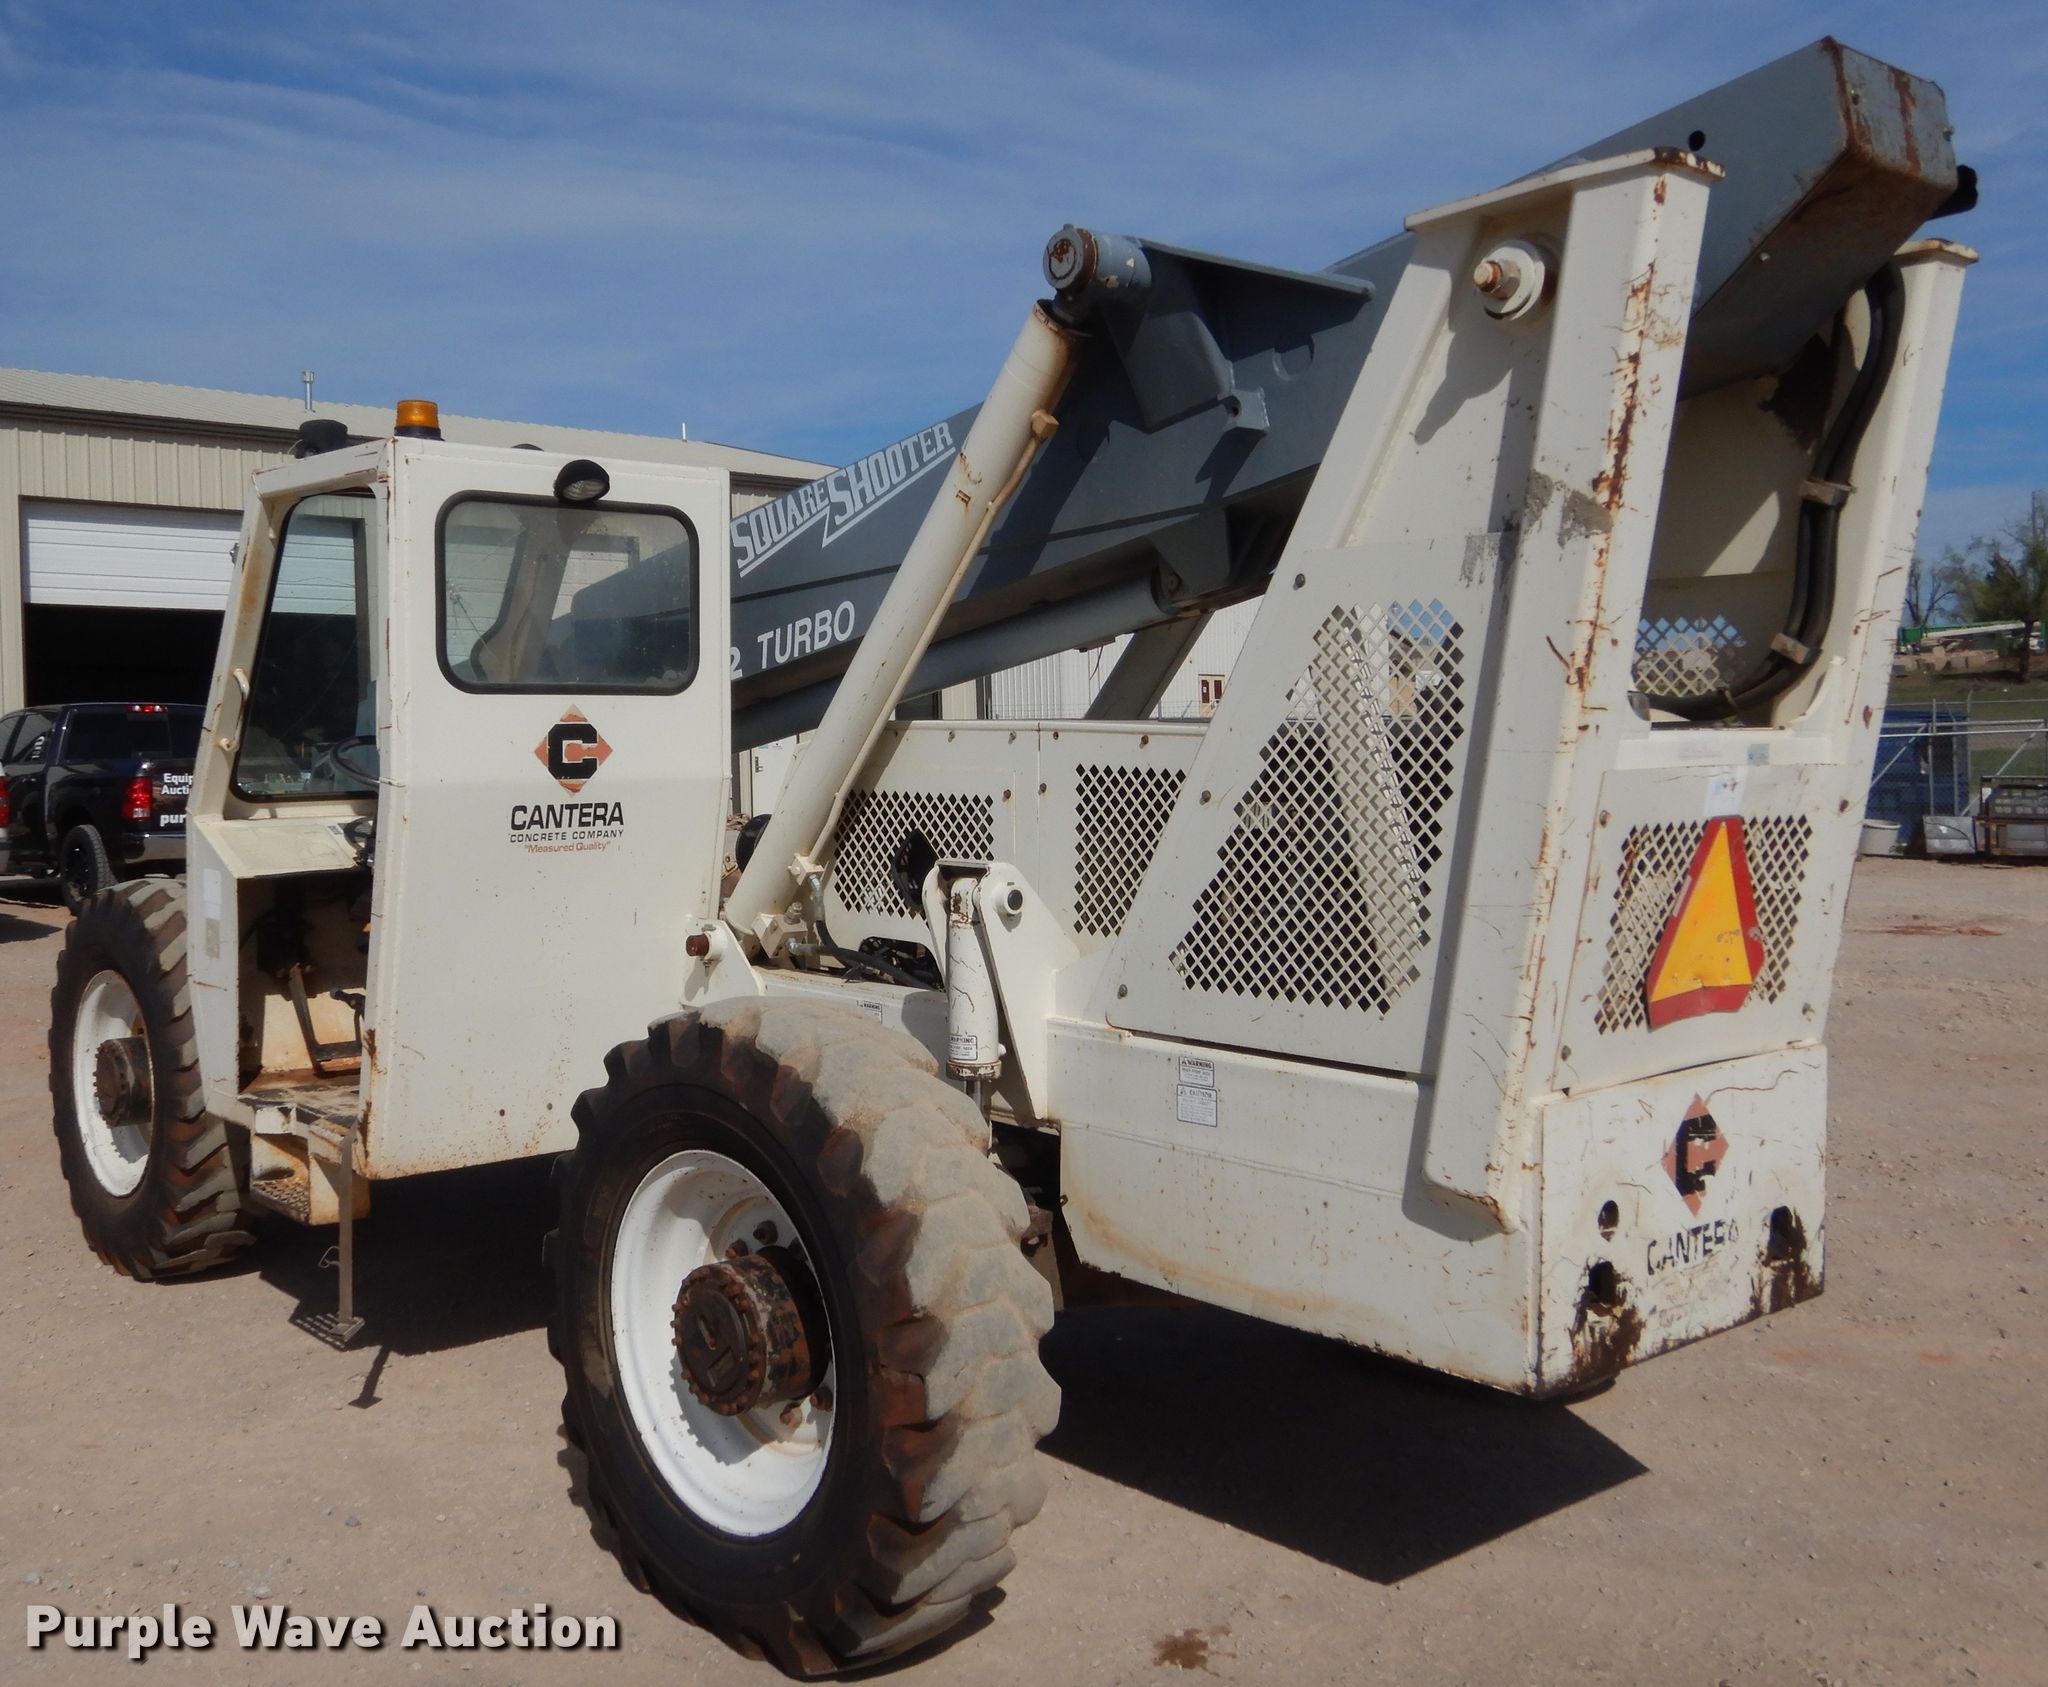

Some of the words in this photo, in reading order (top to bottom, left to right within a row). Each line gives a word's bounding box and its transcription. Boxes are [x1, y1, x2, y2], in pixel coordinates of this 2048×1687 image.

[730, 479, 829, 569] SQUARE
[827, 421, 953, 526] SHOOTER
[757, 600, 855, 669] TURBO
[510, 801, 624, 831] CANTERA
[510, 831, 567, 843] CONCRETE
[572, 829, 624, 840] COMPANY
